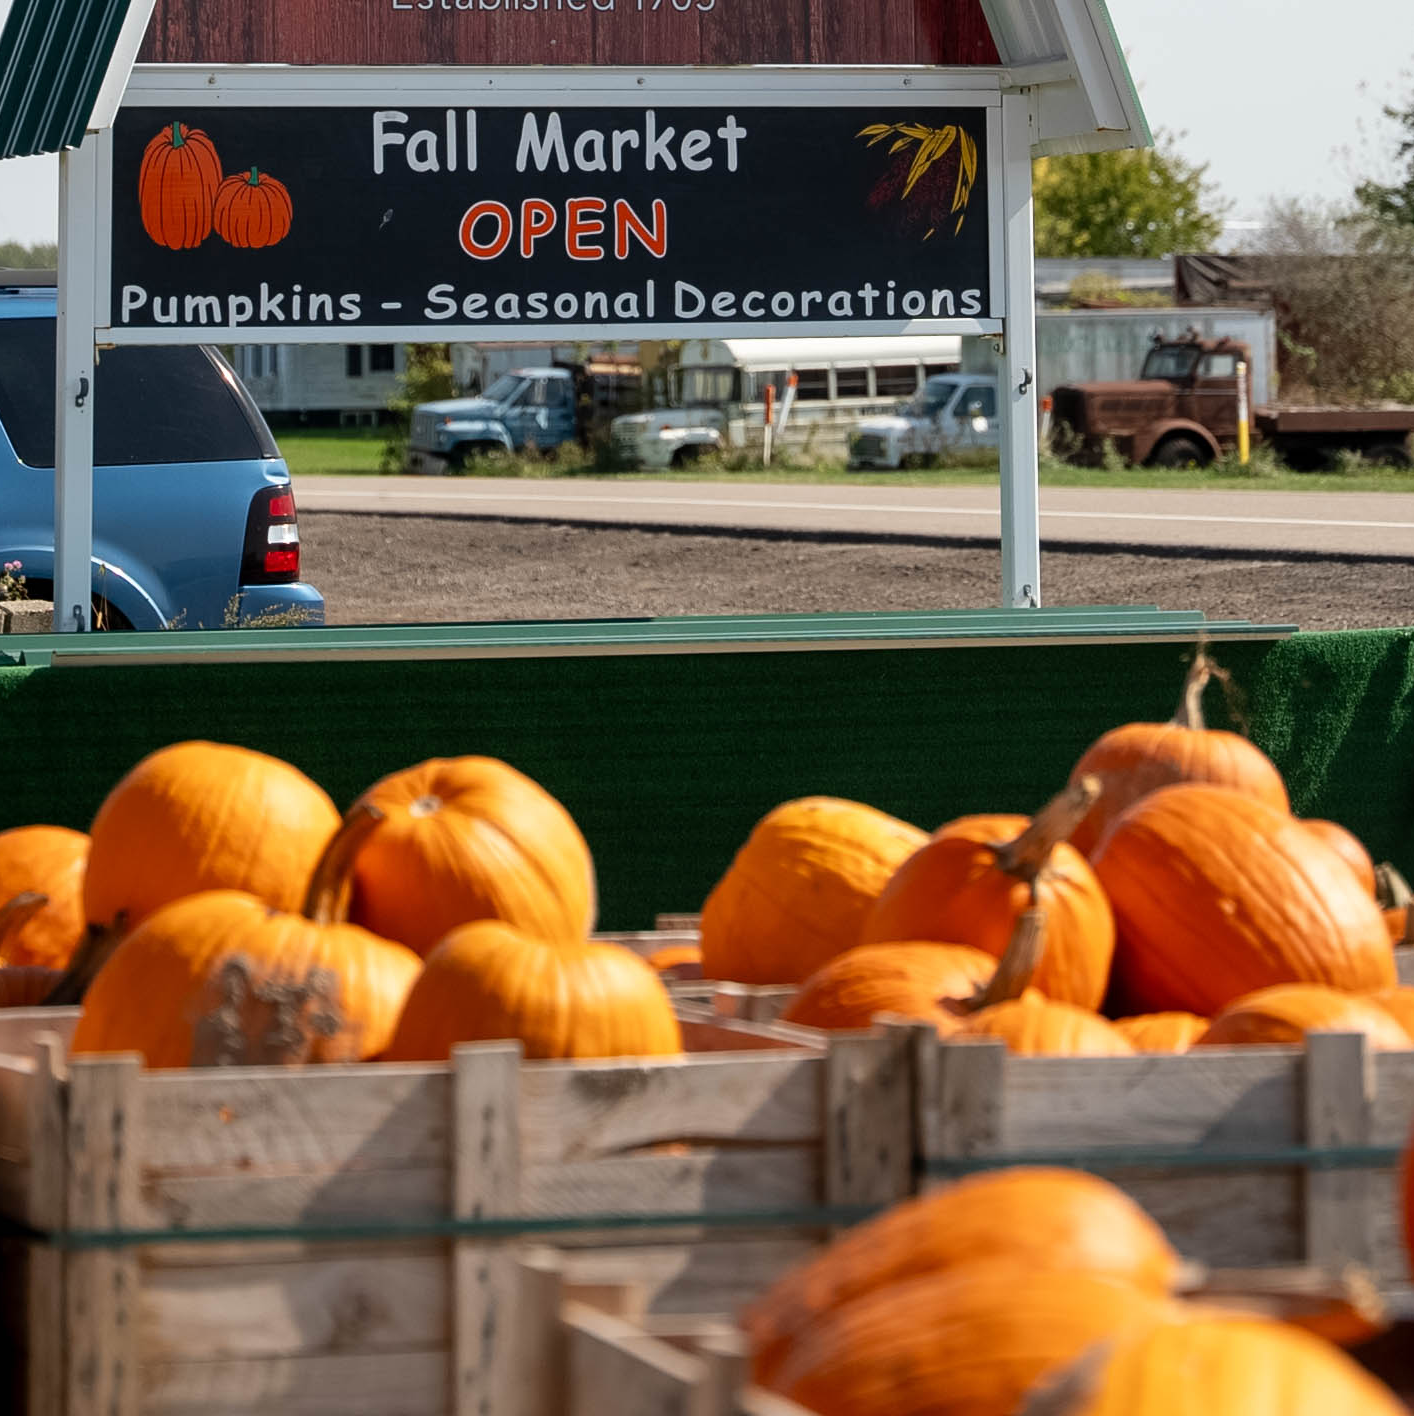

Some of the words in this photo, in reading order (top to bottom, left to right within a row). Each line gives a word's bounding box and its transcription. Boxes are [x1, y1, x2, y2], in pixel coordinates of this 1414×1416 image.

[371, 109, 479, 175] Fall
[515, 109, 748, 174] Market
[457, 196, 670, 261] OPEN
[121, 282, 362, 326] Pumpkins
[424, 279, 656, 321] Seasonal
[674, 280, 983, 320] Decorations
